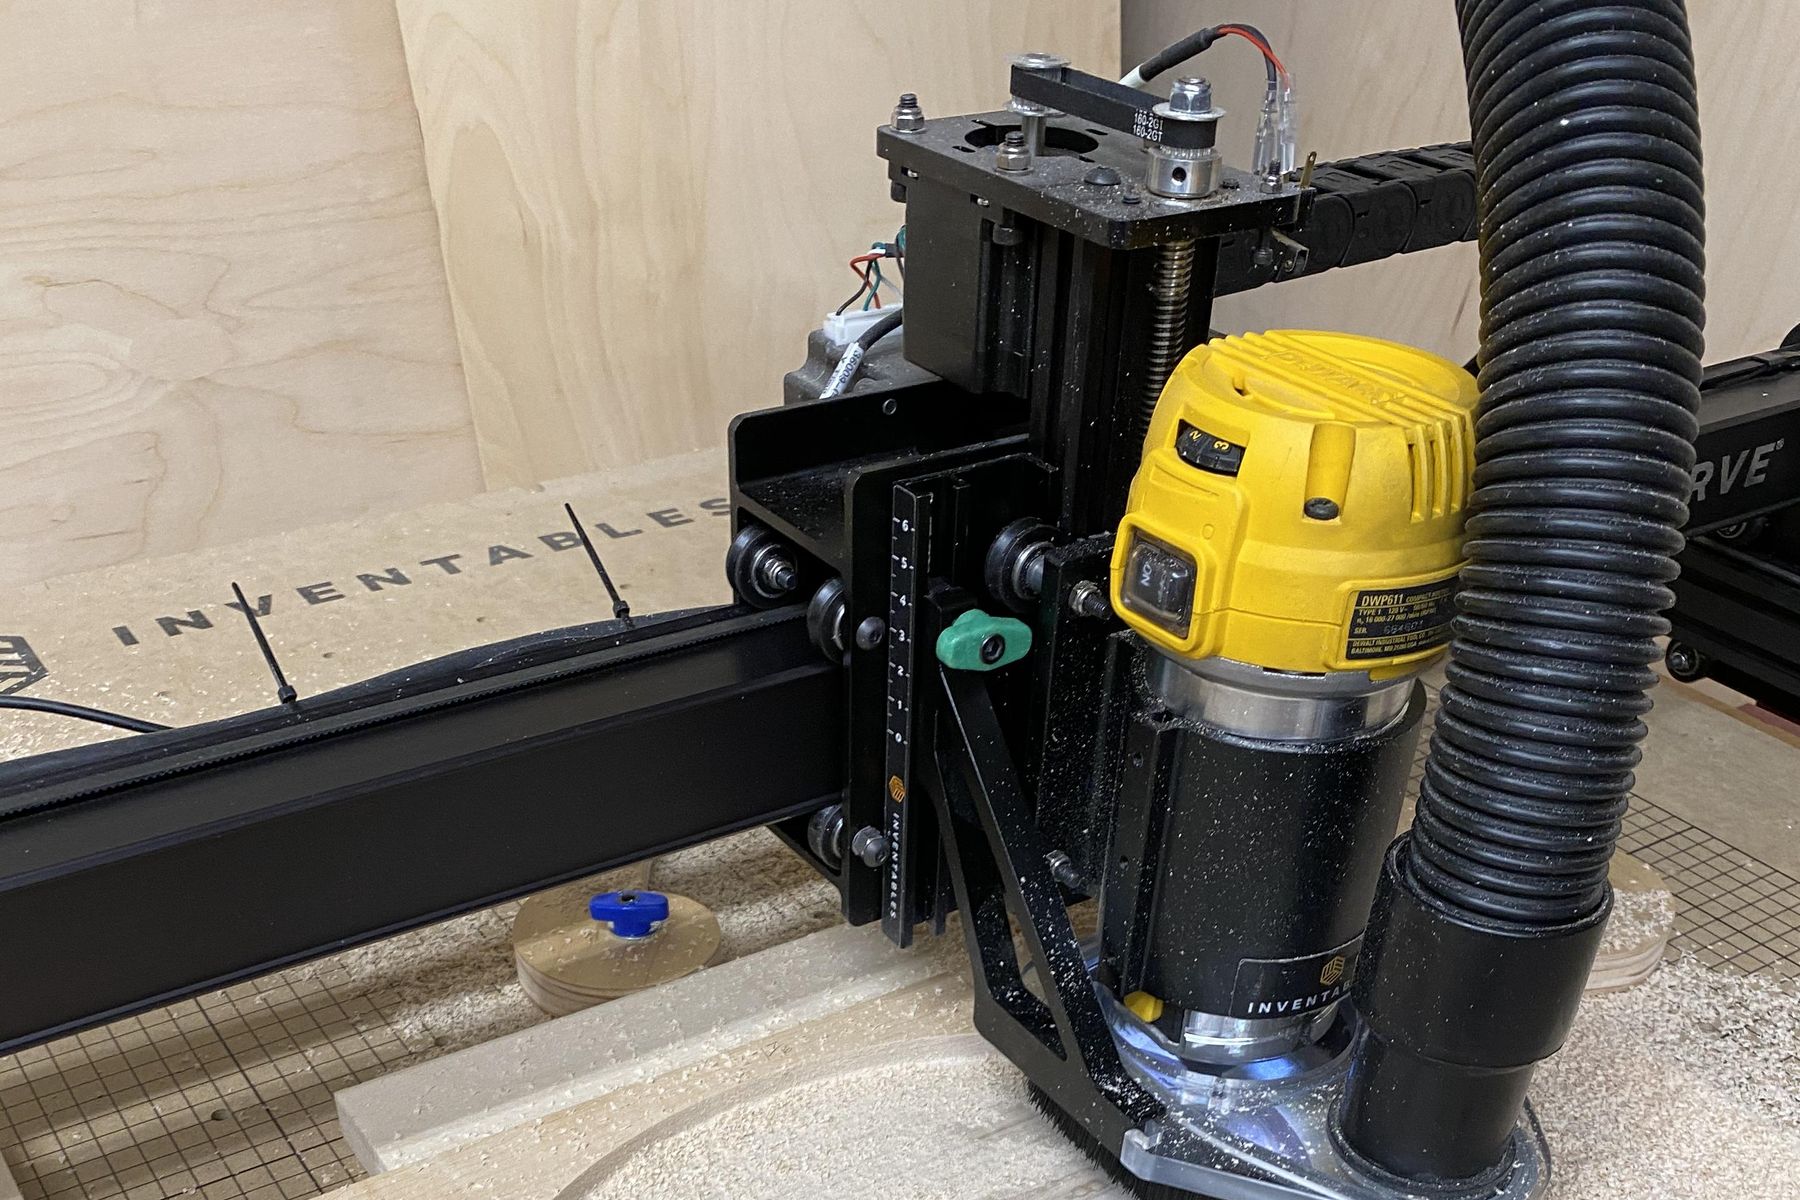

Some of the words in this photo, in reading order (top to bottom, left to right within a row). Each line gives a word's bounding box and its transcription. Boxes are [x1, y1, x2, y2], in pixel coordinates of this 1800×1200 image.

[1133, 124, 1163, 142] 160-2GT
[902, 519, 909, 532] 6
[901, 556, 908, 570] 5
[112, 498, 731, 646] INVENTABLES
[899, 594, 907, 607] 4
[1361, 594, 1404, 607] DWP611
[898, 629, 905, 642] 3
[897, 665, 904, 677] 2
[895, 732, 902, 743] 0
[889, 812, 900, 919] INVENTABLES
